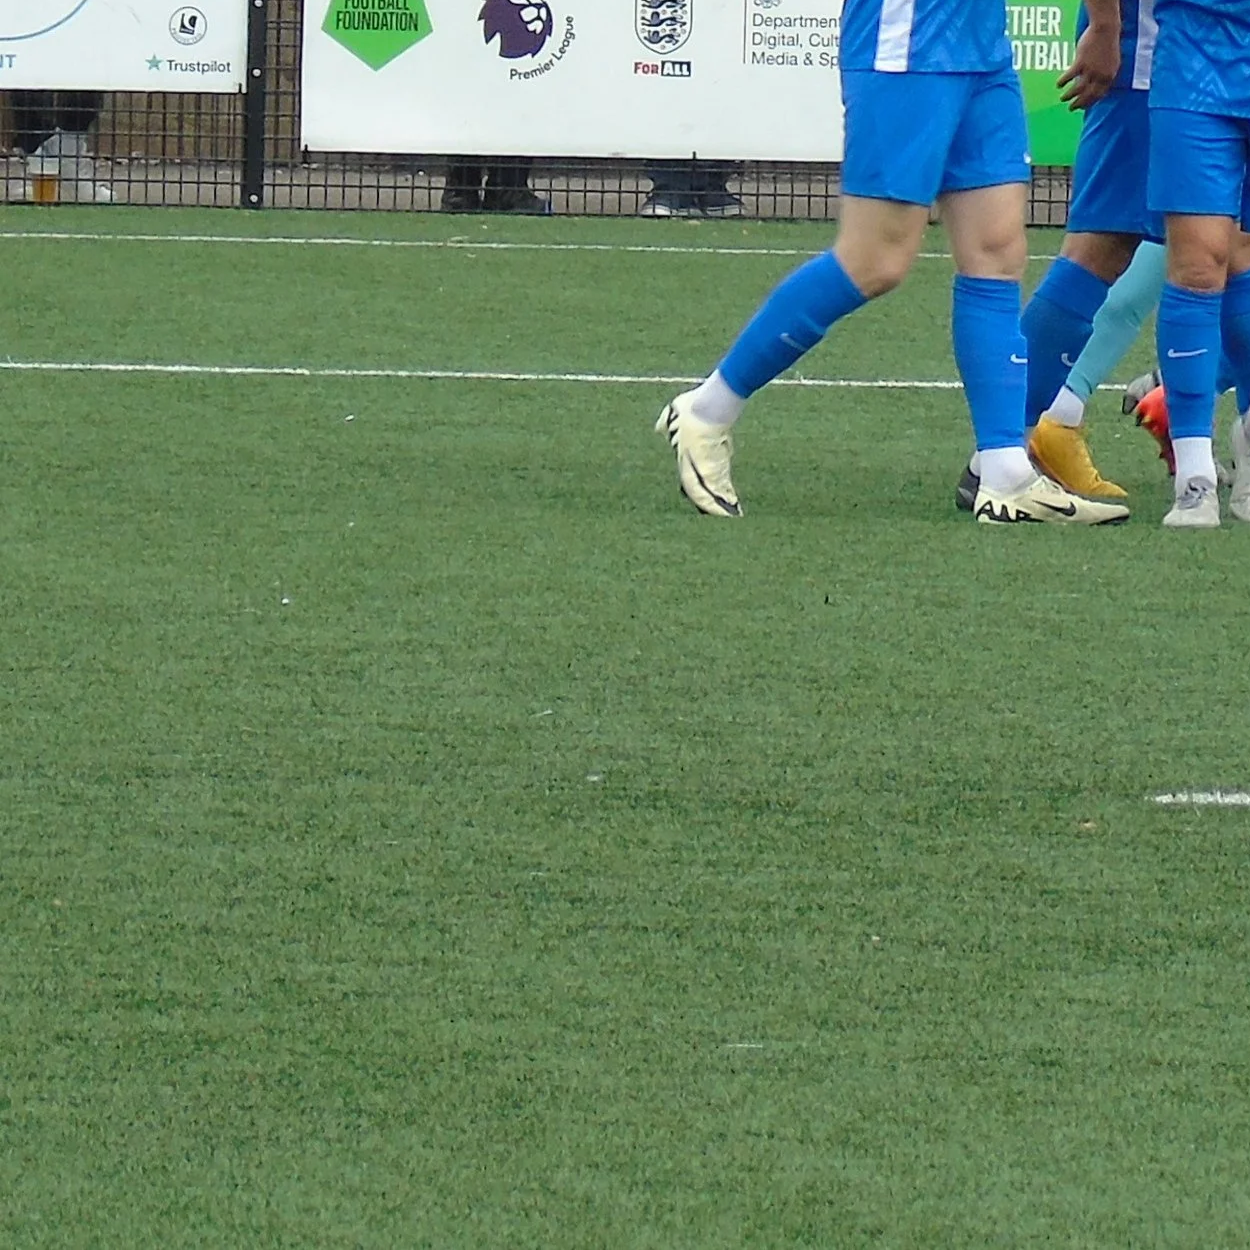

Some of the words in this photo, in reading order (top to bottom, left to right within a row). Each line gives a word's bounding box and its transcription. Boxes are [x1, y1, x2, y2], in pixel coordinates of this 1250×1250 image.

[336, 11, 419, 32] FOUNDATION
[509, 59, 556, 81] Premier
[552, 15, 576, 62] League
[752, 32, 803, 49] Digital,
[809, 32, 839, 48] Cult
[751, 51, 798, 66] Media
[803, 51, 814, 66] &
[1010, 40, 1071, 71] OTBAL
[167, 59, 231, 75] Trustpilot
